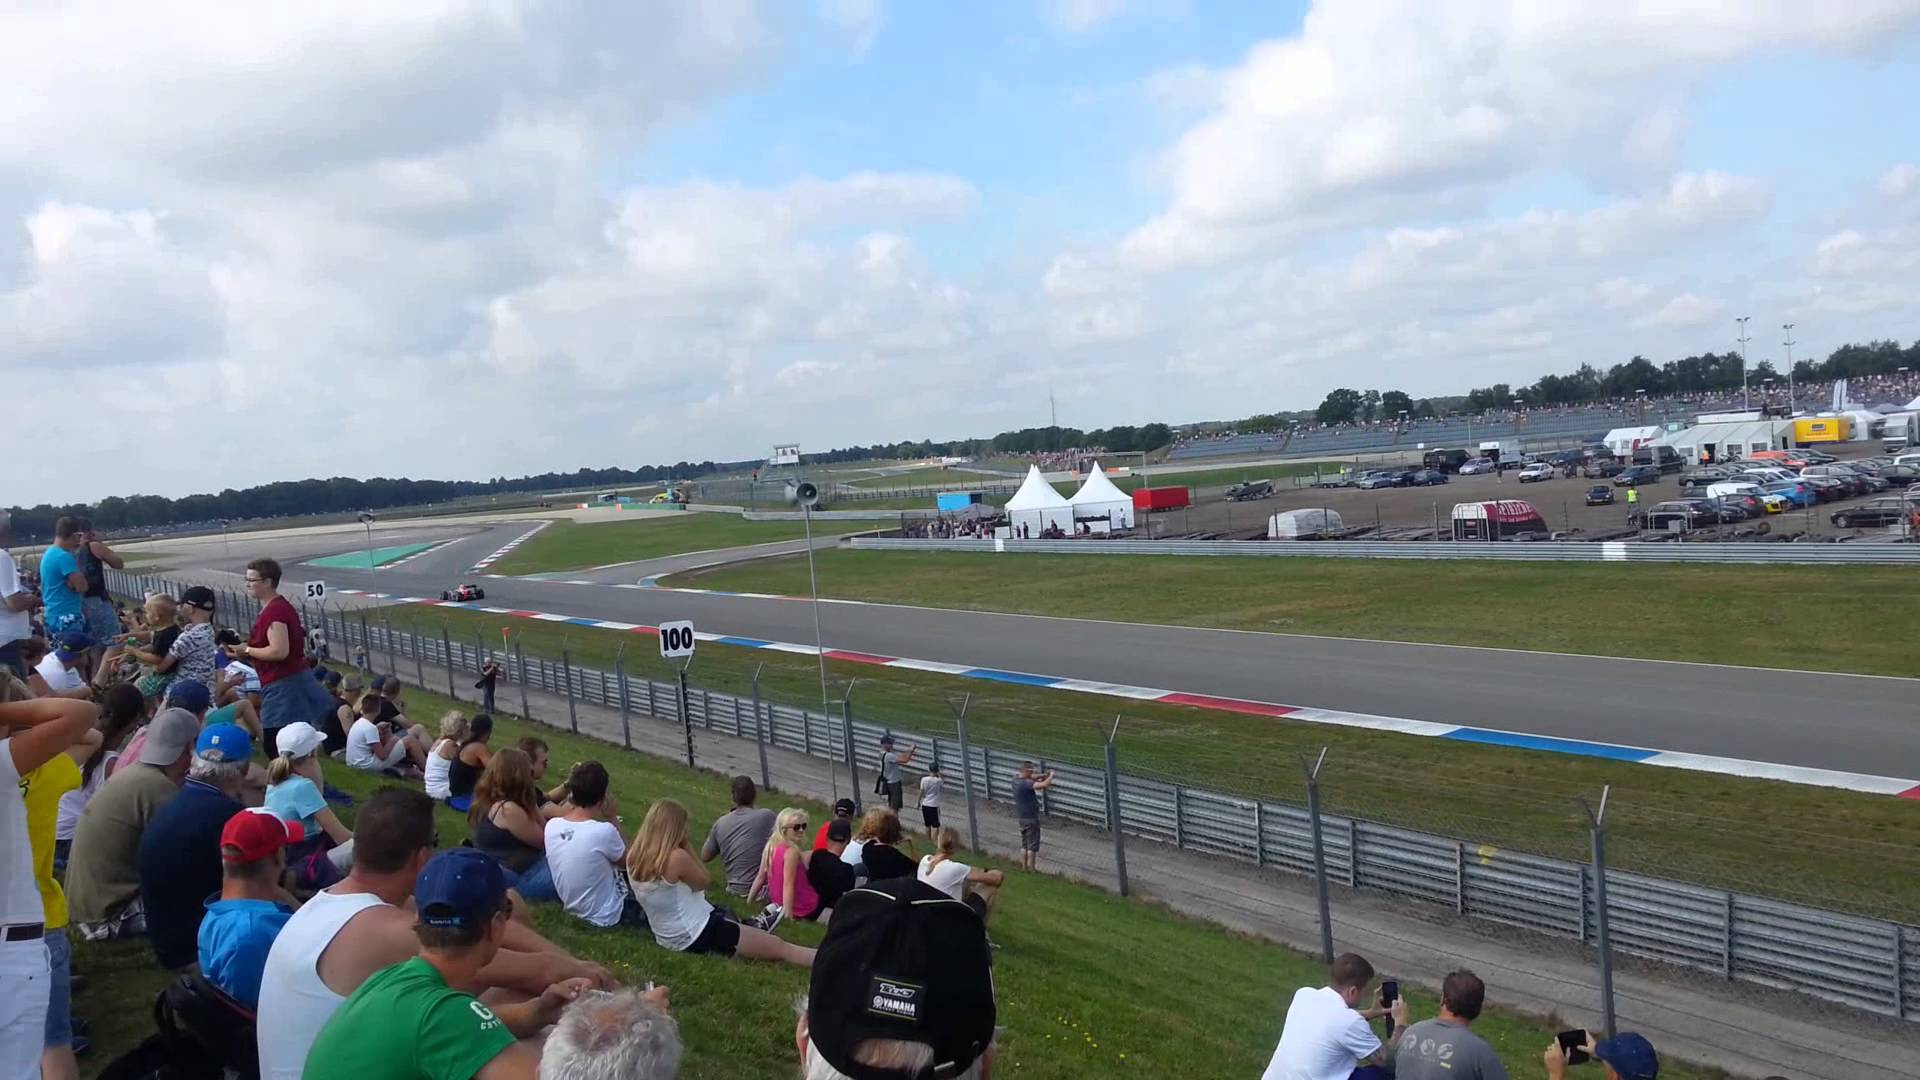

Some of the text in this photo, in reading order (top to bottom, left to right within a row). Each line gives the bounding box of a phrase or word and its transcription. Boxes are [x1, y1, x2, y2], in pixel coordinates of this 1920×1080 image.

[308, 584, 324, 597] 50
[661, 626, 693, 651] 100
[883, 997, 916, 1013] YAMAHA
